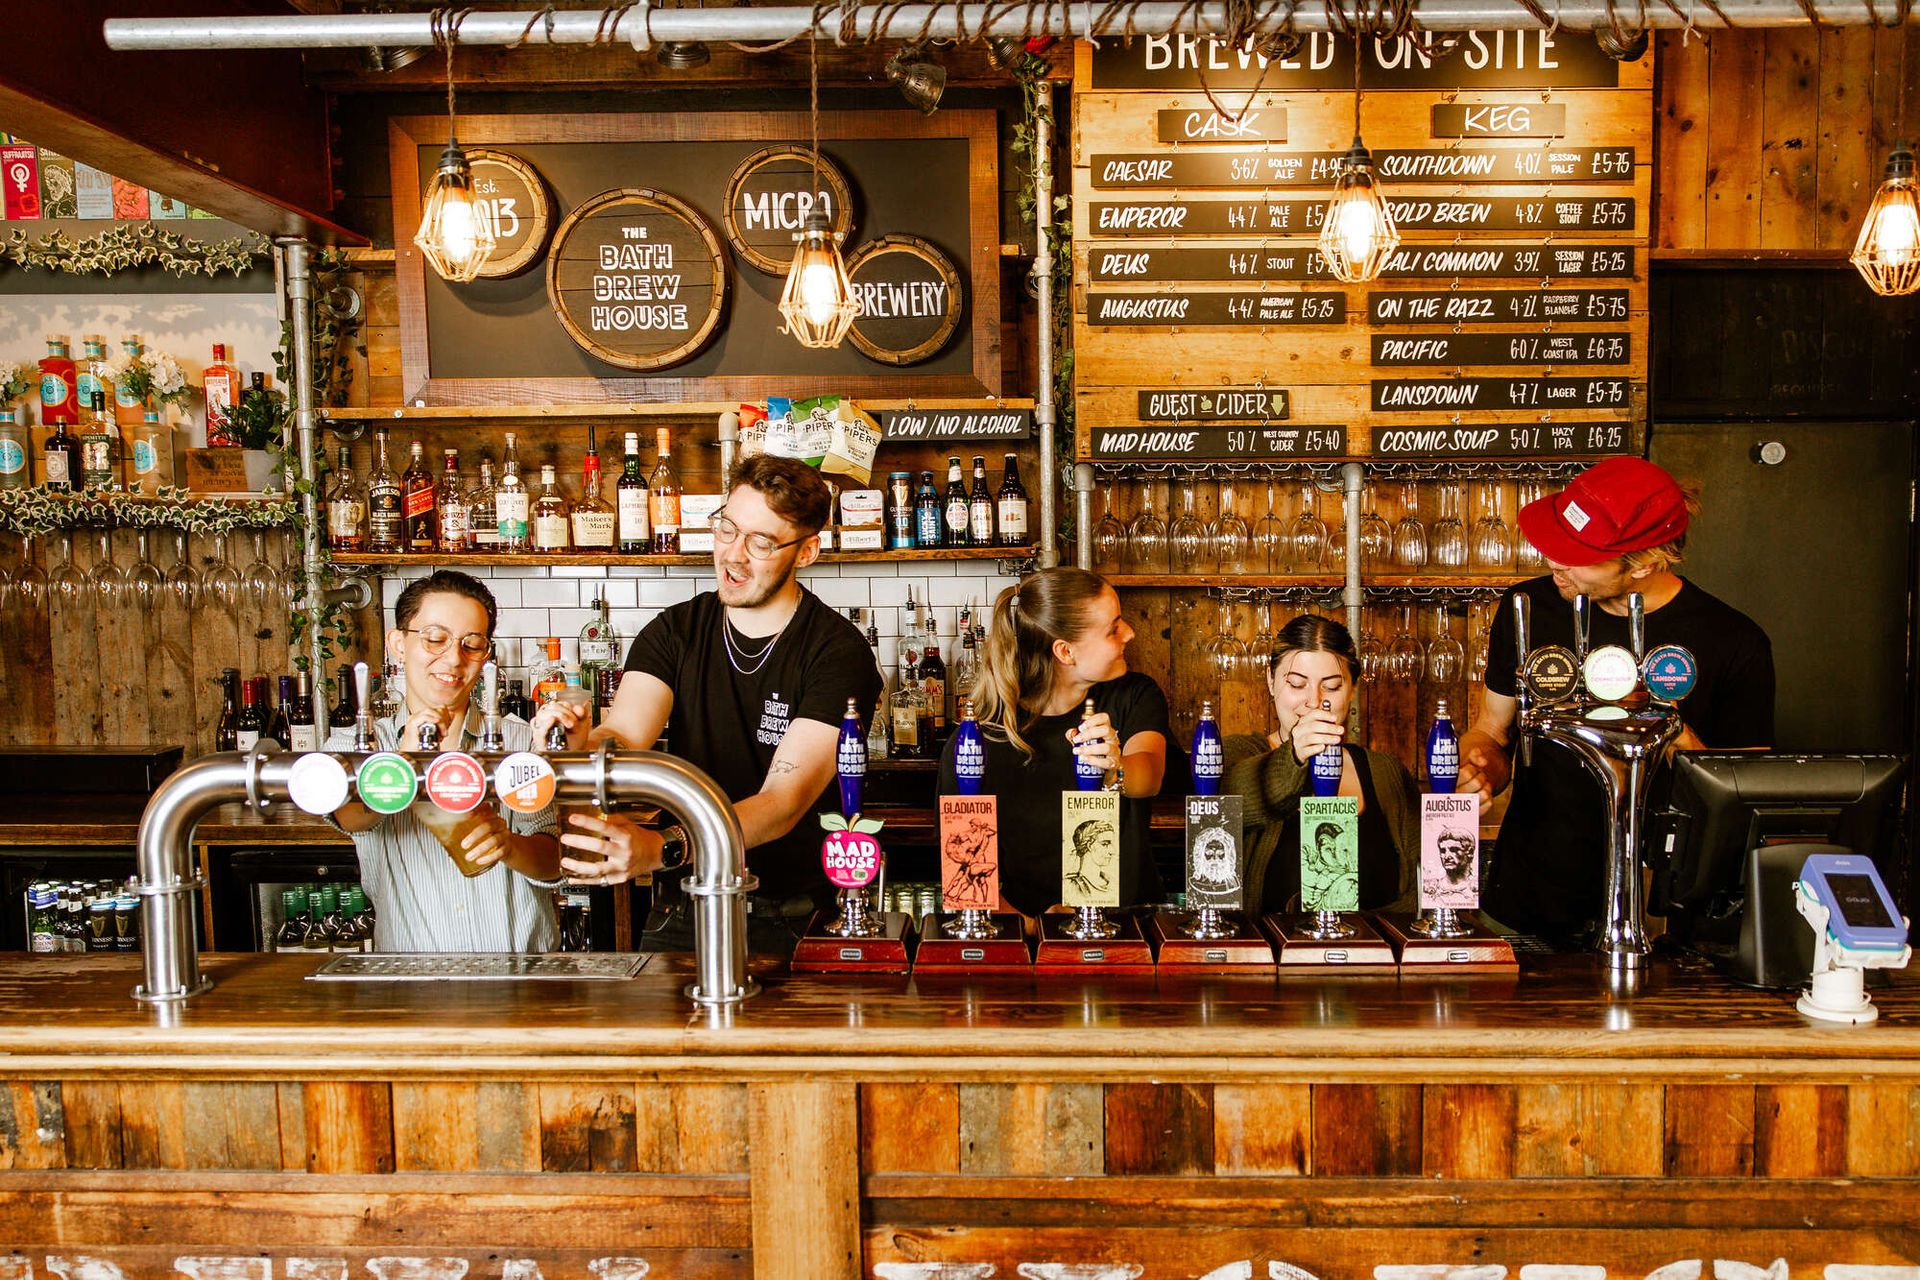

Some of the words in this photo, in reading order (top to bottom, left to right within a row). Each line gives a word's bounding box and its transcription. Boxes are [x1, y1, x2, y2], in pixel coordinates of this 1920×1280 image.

[1145, 31, 1335, 70] BREWD
[1184, 112, 1262, 138] CASK
[1464, 106, 1530, 132] KEG
[1268, 158, 1303, 168] GOLDEN
[1379, 155, 1496, 177] SOUTHDOWN
[1548, 153, 1581, 163] SESSION
[1103, 160, 1173, 183] CAESAR
[1274, 168, 1297, 180] ALE
[1551, 164, 1574, 174] PALE
[475, 175, 500, 194] Est.
[743, 191, 831, 230] MICRO
[1269, 205, 1290, 216] PALE
[1432, 203, 1492, 224] BREW
[1555, 203, 1583, 214] COFFEE
[1100, 206, 1187, 229] EMPEROR
[1270, 215, 1289, 228] ALE
[1559, 214, 1581, 225] STOUT
[621, 227, 647, 239] THE
[599, 244, 673, 270] BATH
[1100, 253, 1150, 275] DEUS
[1266, 257, 1295, 270] STOUT
[1423, 251, 1504, 272] COMMON
[1555, 250, 1585, 262] SESSION
[1558, 262, 1582, 274] LAGER
[593, 274, 681, 301] BREW
[851, 281, 947, 318] BREWERY
[1260, 297, 1294, 308] AMERICAN
[1100, 298, 1190, 319] AUGUSTUS
[1259, 309, 1278, 320] PALE
[1279, 308, 1295, 320] ALE
[1377, 298, 1404, 319] ON
[1408, 299, 1442, 318] THE
[1444, 298, 1495, 318] RAZZ
[1544, 304, 1580, 316] BLANCHE
[591, 305, 689, 331] HOUSE
[1380, 340, 1449, 361] PACIFIC
[1550, 337, 1574, 348] WEST
[1543, 349, 1565, 361] COAST
[1565, 349, 1579, 360] IPA
[1380, 384, 1479, 406] LANSDOWN
[1547, 387, 1577, 399] LAGER
[1150, 393, 1198, 418] GUEST
[1215, 393, 1269, 417] CIDER
[888, 415, 928, 437] LOW
[961, 414, 1023, 435] ALCOHOL
[1551, 427, 1576, 437] HAZY
[843, 425, 878, 448] PIPERS
[1100, 433, 1141, 453] MAD
[1141, 431, 1200, 453] HOUSE
[1263, 430, 1278, 439] WEST
[1380, 430, 1447, 452] COSMIC
[1447, 428, 1500, 451] SOUP
[1270, 439, 1295, 453] CIDER
[1554, 437, 1573, 450] IPA
[764, 700, 789, 717] BATH
[760, 714, 790, 733] BREW
[756, 729, 785, 746] HOUS
[510, 765, 541, 788] JUBEL
[944, 802, 993, 815] GLADIATOR
[1067, 797, 1115, 810] EMPEROR
[1190, 801, 1219, 815] DEUS
[1304, 801, 1357, 815] SPARTACUS
[1425, 799, 1472, 812] AUGUSTUS
[826, 840, 876, 857] MAD
[825, 856, 876, 869] HOUSE
